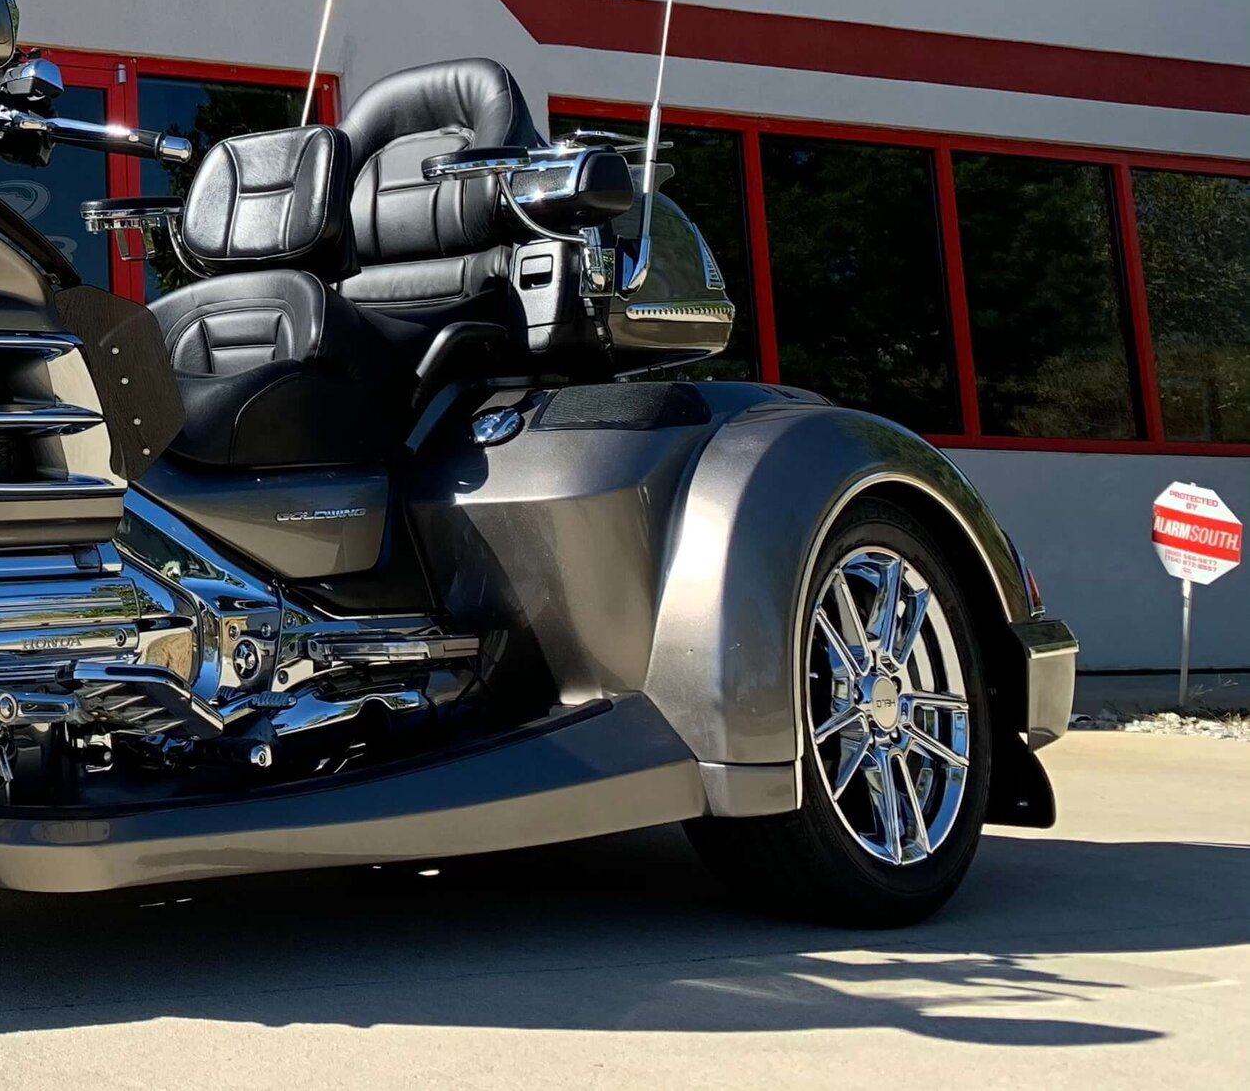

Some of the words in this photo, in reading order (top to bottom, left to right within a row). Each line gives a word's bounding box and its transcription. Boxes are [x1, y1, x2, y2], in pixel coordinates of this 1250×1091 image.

[1169, 490, 1219, 507] PROTECTED
[1186, 503, 1198, 511] BY
[1153, 516, 1240, 552] ALARMSOUTH
[21, 636, 82, 650] HONDA
